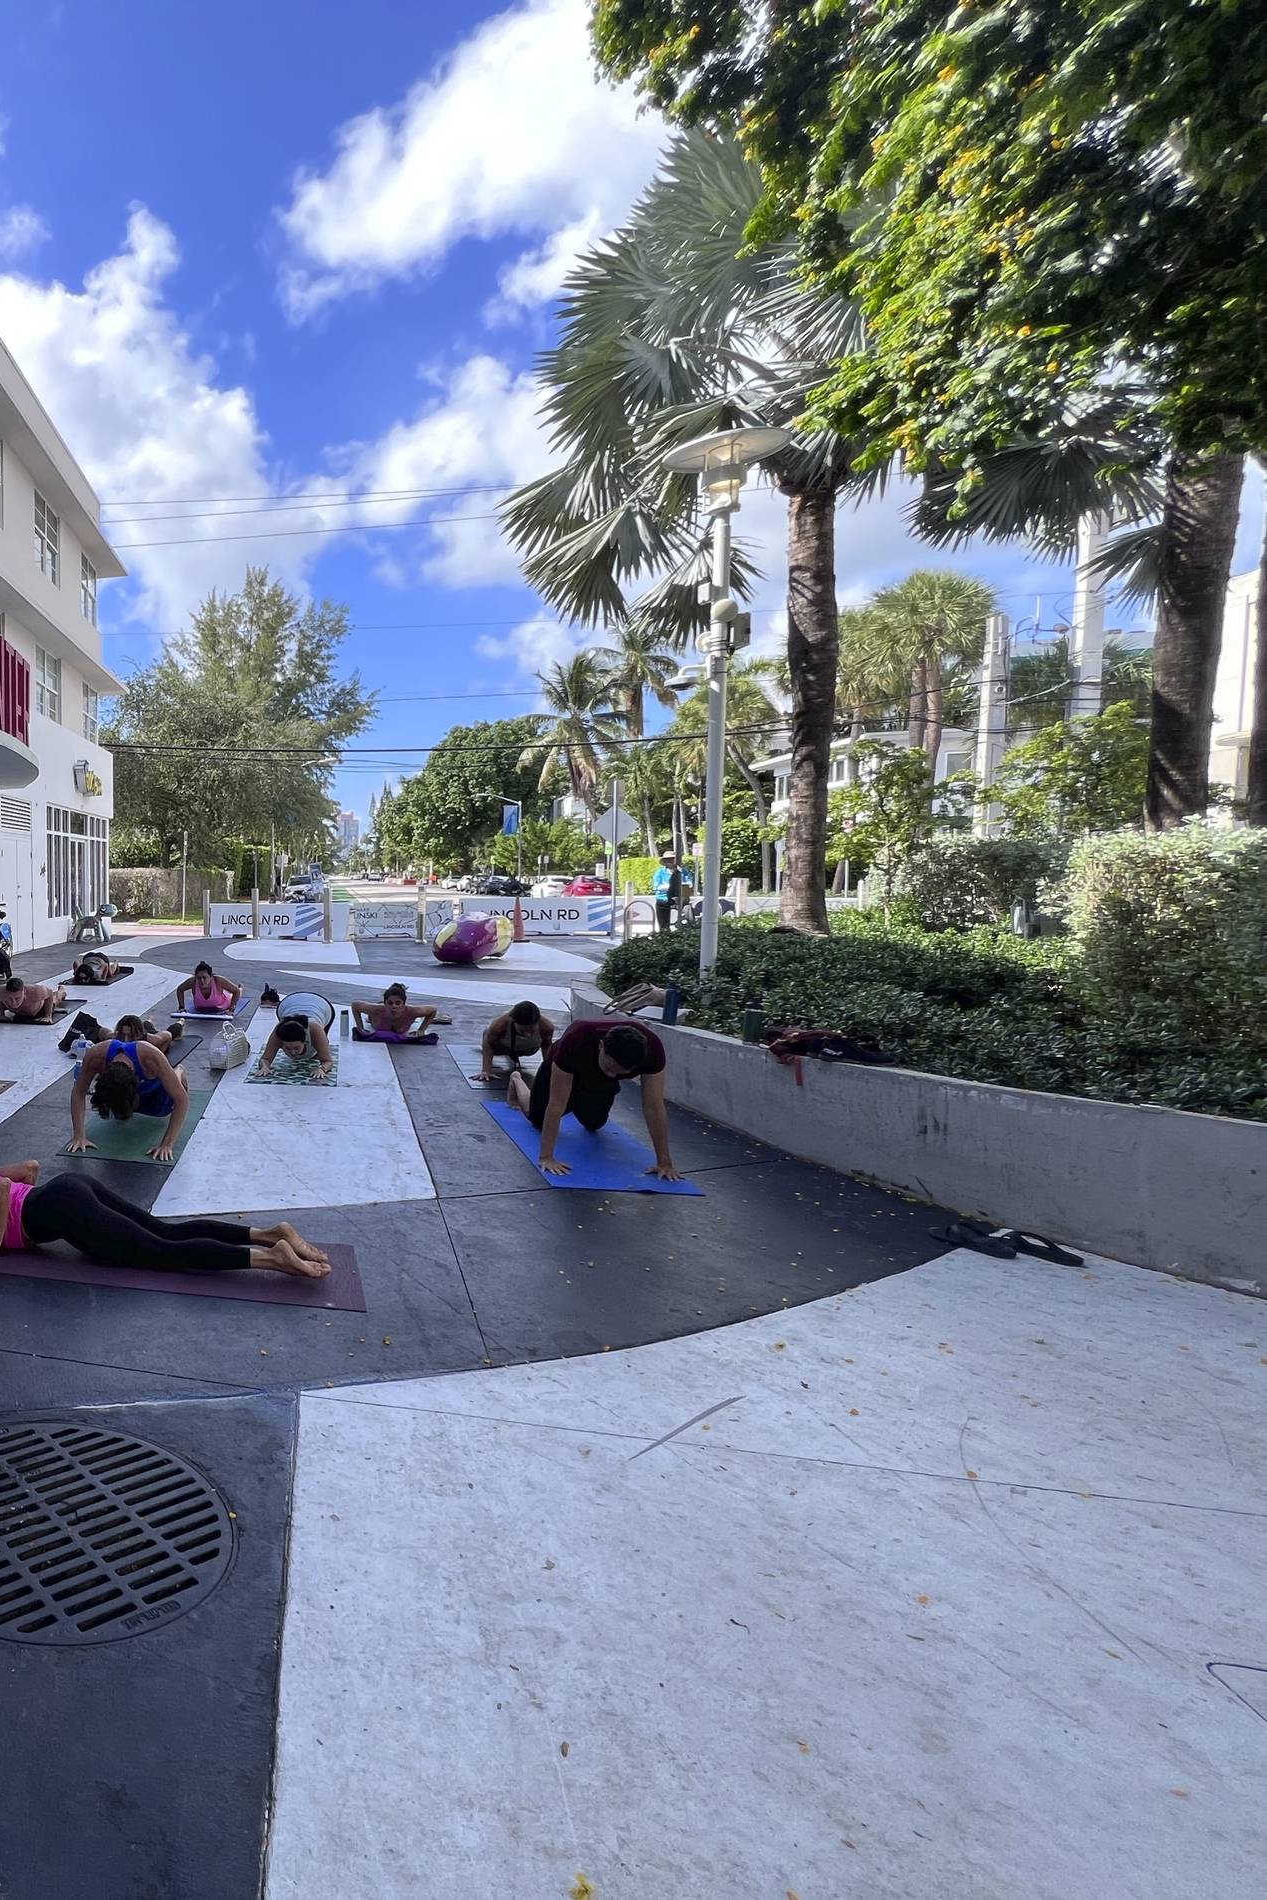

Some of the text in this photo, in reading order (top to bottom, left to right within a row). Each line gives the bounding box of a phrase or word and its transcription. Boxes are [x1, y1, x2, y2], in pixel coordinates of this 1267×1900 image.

[221, 914, 290, 926] LINCON RD
[557, 909, 580, 921] RD
